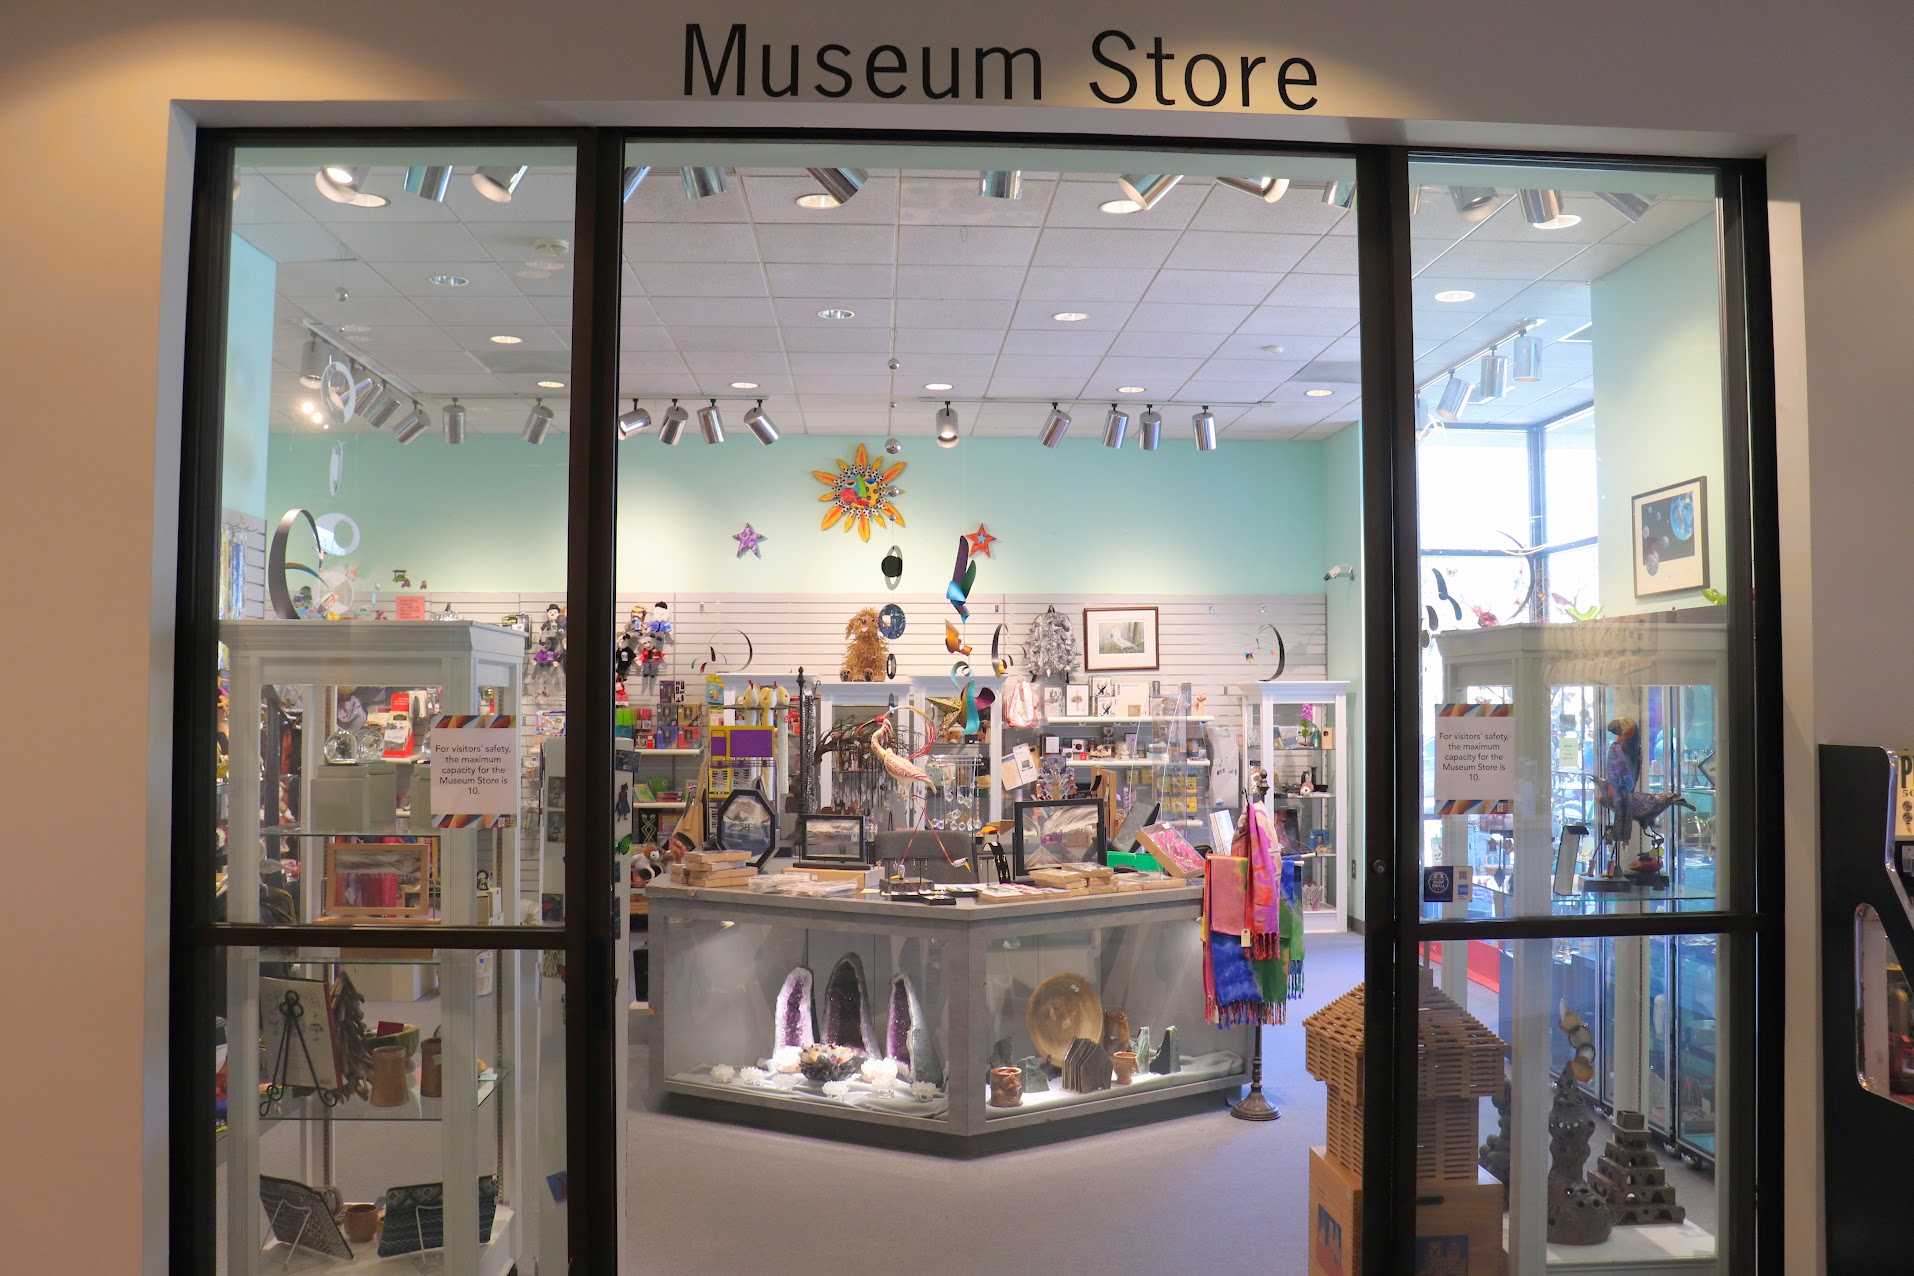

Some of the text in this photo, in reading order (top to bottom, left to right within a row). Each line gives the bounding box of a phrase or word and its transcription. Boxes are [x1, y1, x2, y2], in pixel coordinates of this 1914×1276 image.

[683, 23, 1319, 111] Museum Store
[1439, 732, 1452, 740] For
[1484, 732, 1509, 742] safety,
[435, 744, 449, 753] For
[485, 744, 511, 755] safety,
[445, 755, 502, 763] the maximum
[1444, 753, 1476, 762] capacity
[1478, 752, 1489, 760] for
[441, 765, 506, 775] capacity for the
[1442, 763, 1506, 771] Museum Store is
[439, 776, 508, 785] Museum Store is
[1469, 773, 1480, 781] 10.
[468, 787, 480, 795] 10.
